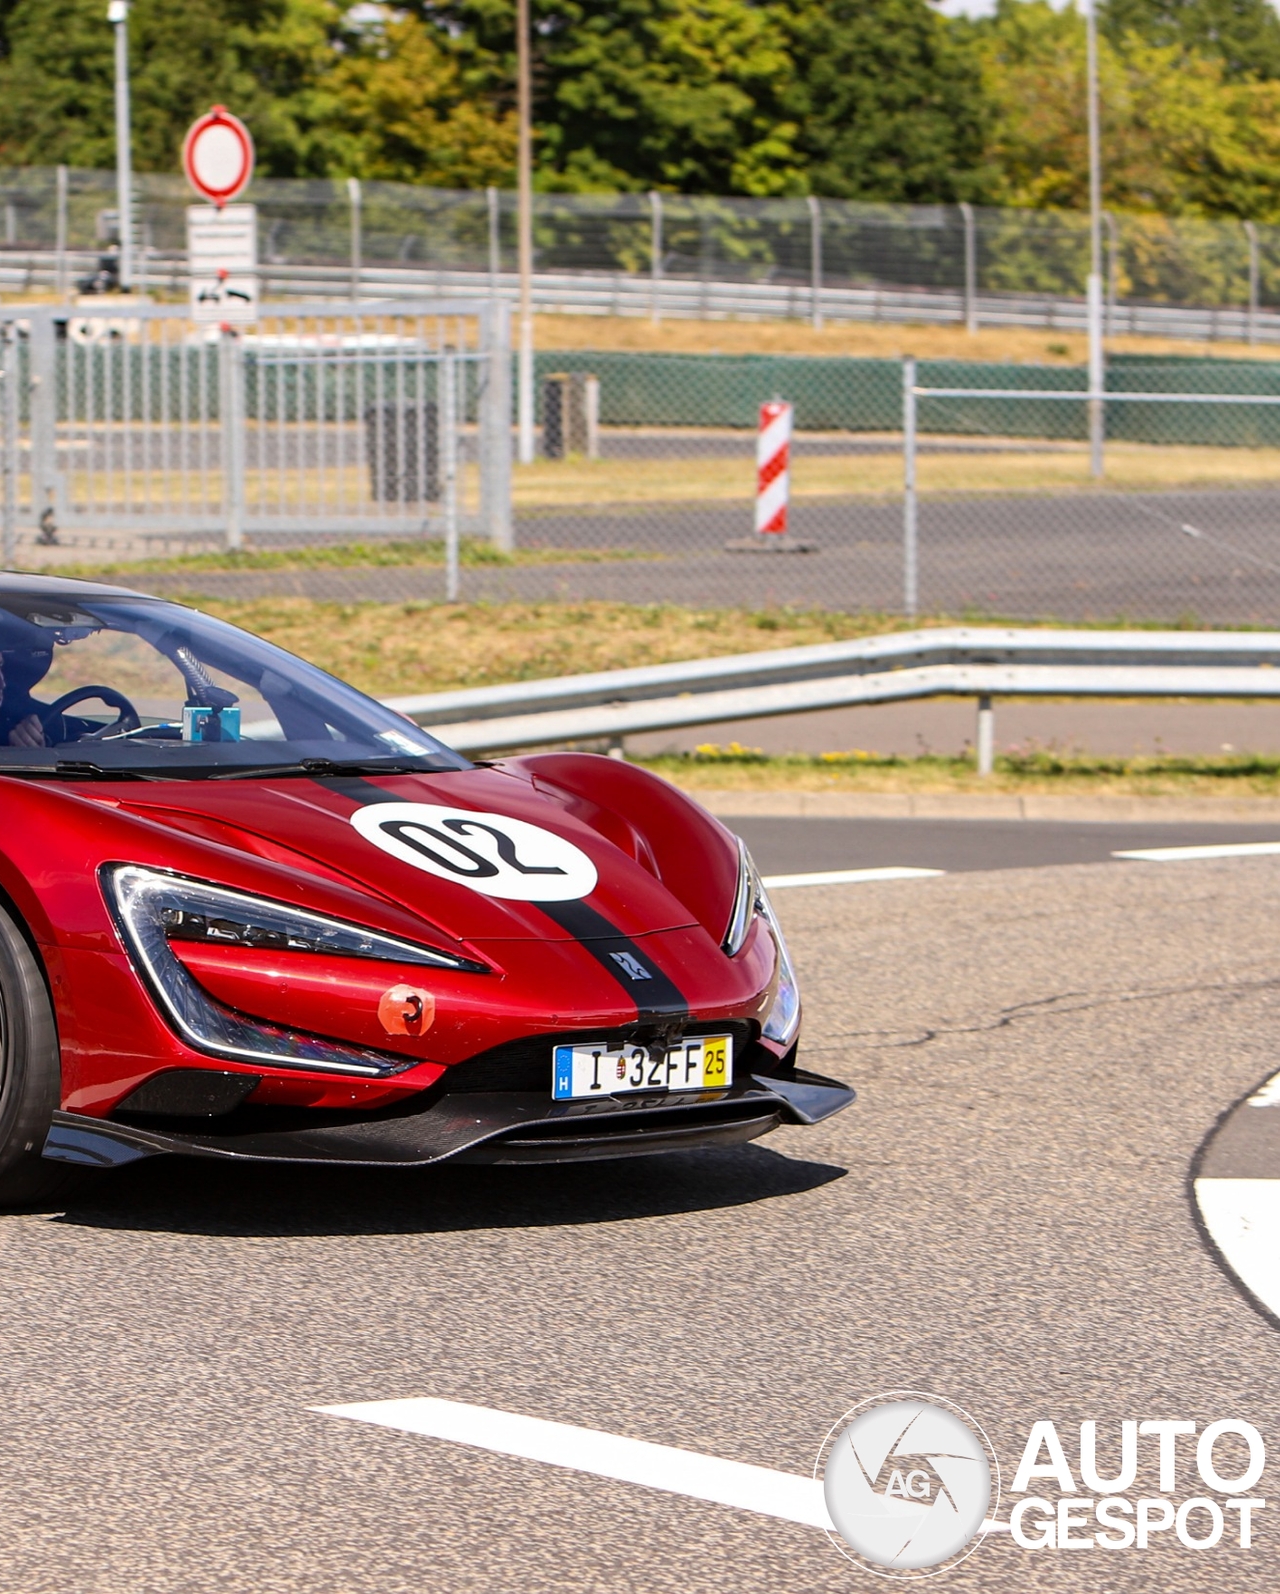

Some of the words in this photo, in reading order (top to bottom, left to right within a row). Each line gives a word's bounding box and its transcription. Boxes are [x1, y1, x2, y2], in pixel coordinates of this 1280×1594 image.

[378, 818, 569, 878] 02
[705, 1049, 725, 1075] 25
[558, 1076, 569, 1091] H
